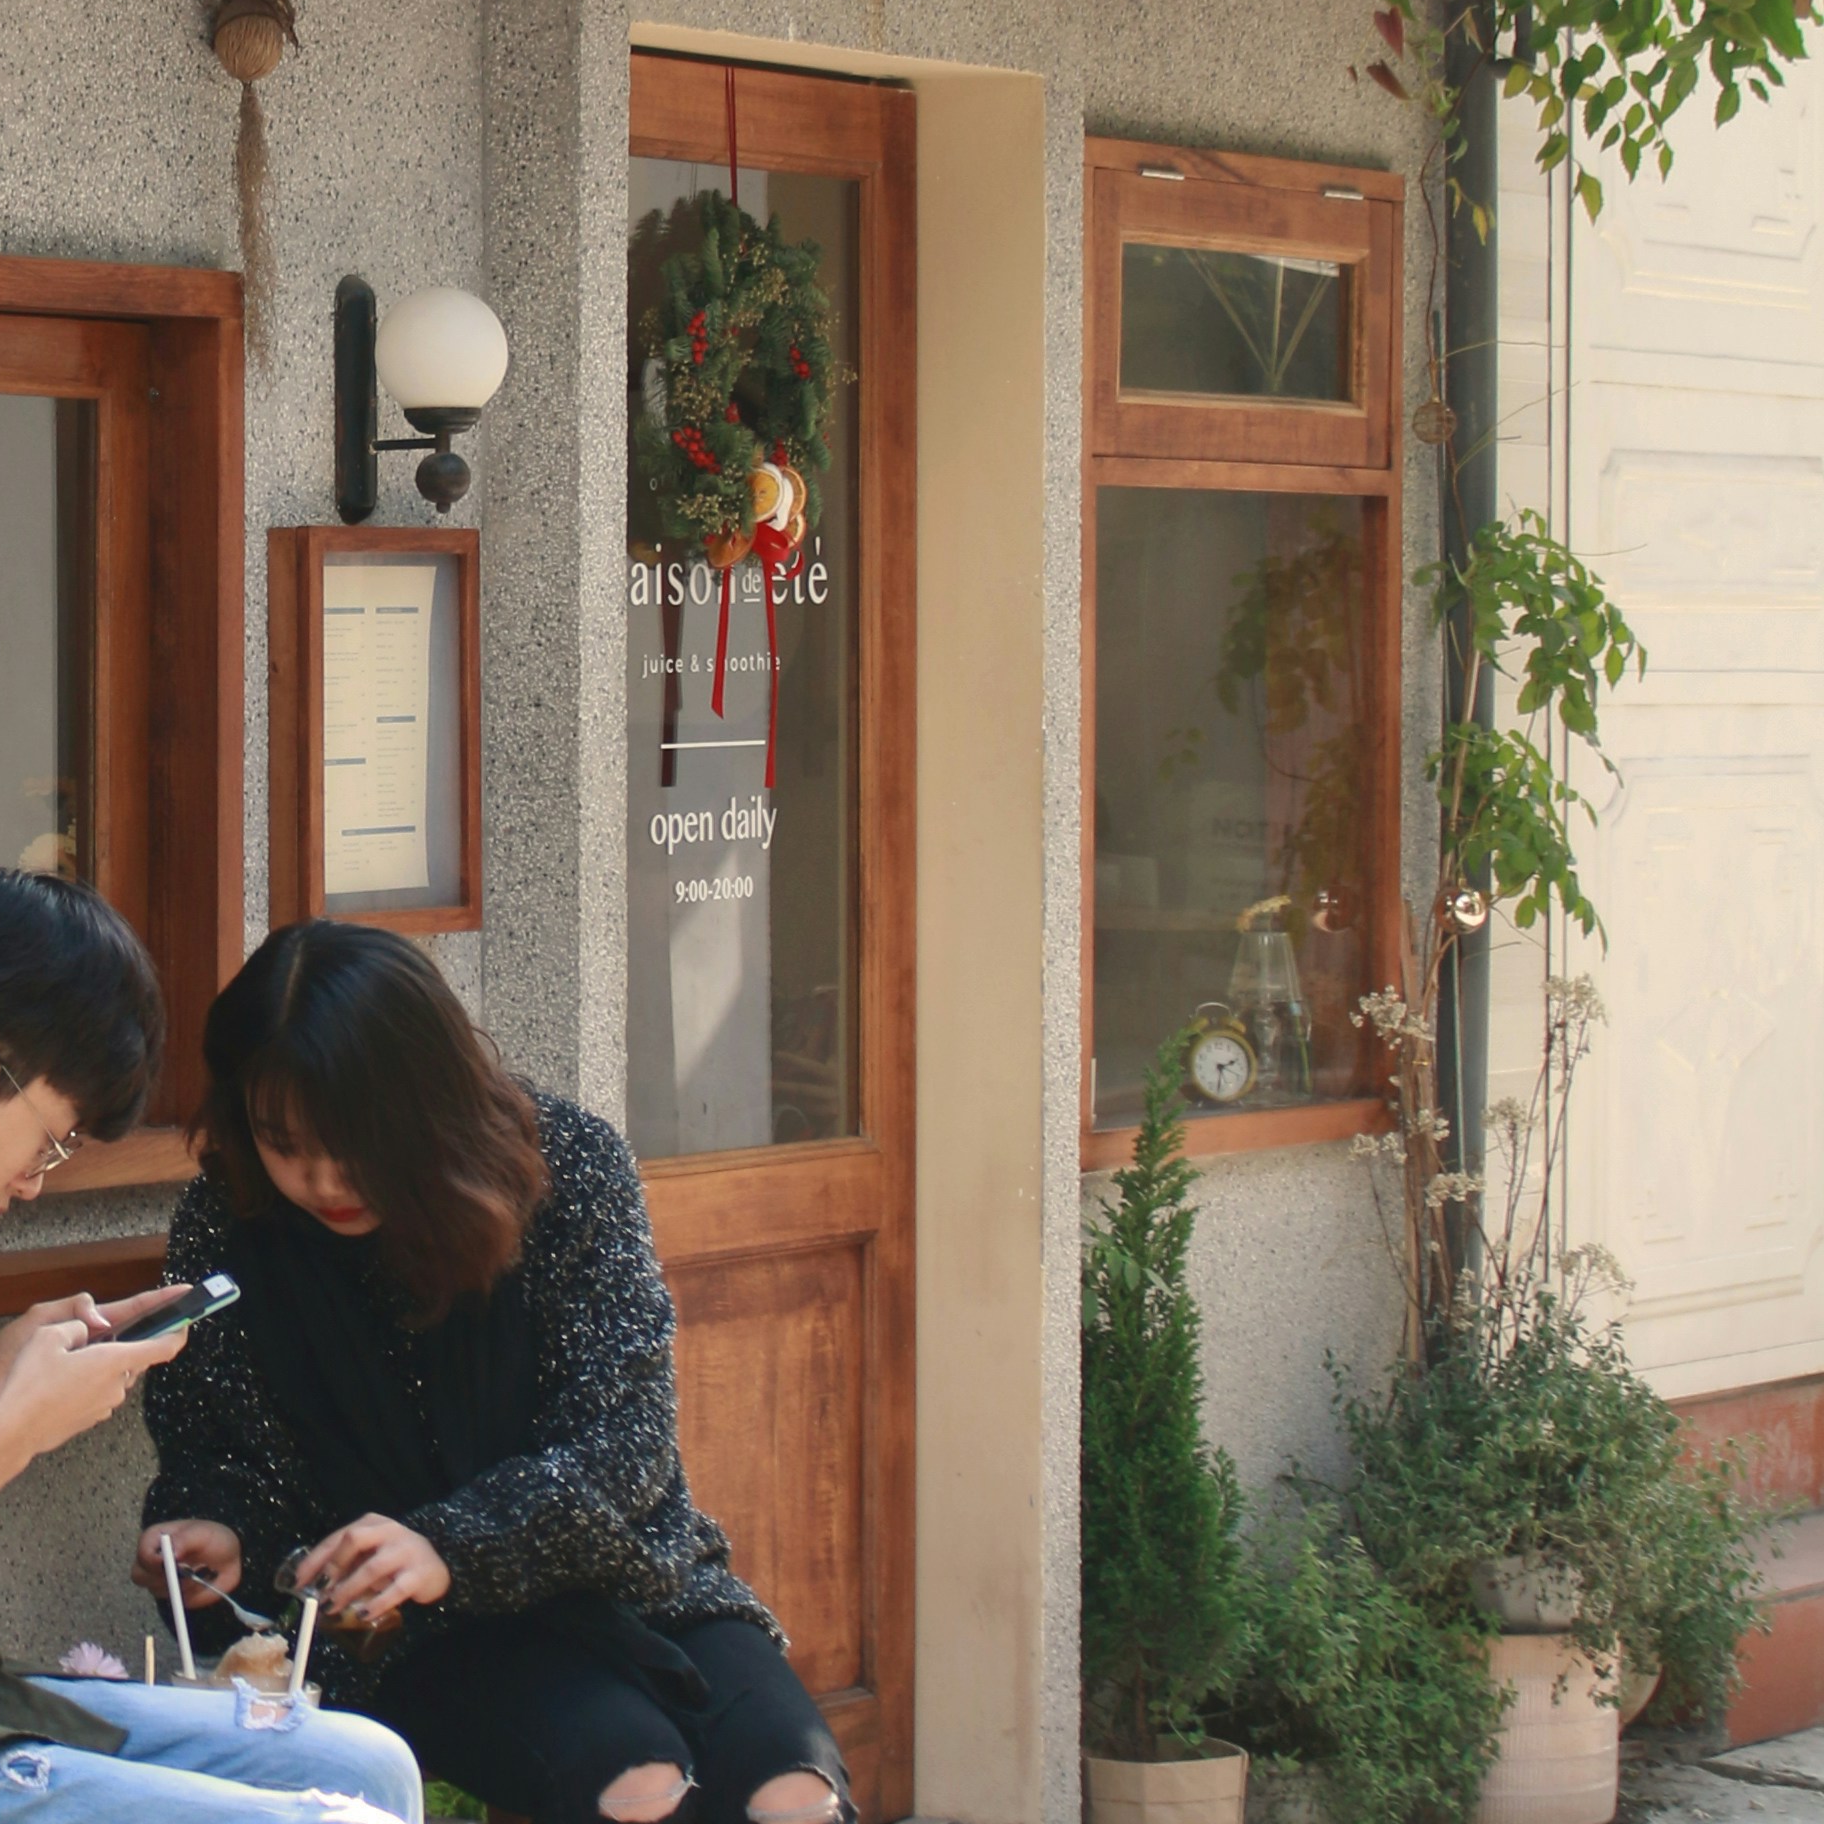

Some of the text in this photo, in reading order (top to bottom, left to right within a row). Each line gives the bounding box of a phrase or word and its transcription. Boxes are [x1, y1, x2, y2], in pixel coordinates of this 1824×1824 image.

[742, 567, 761, 595] de
[642, 651, 781, 679] juice & soothie
[650, 795, 778, 856] open daily
[675, 875, 754, 904] 9:00-20:00
